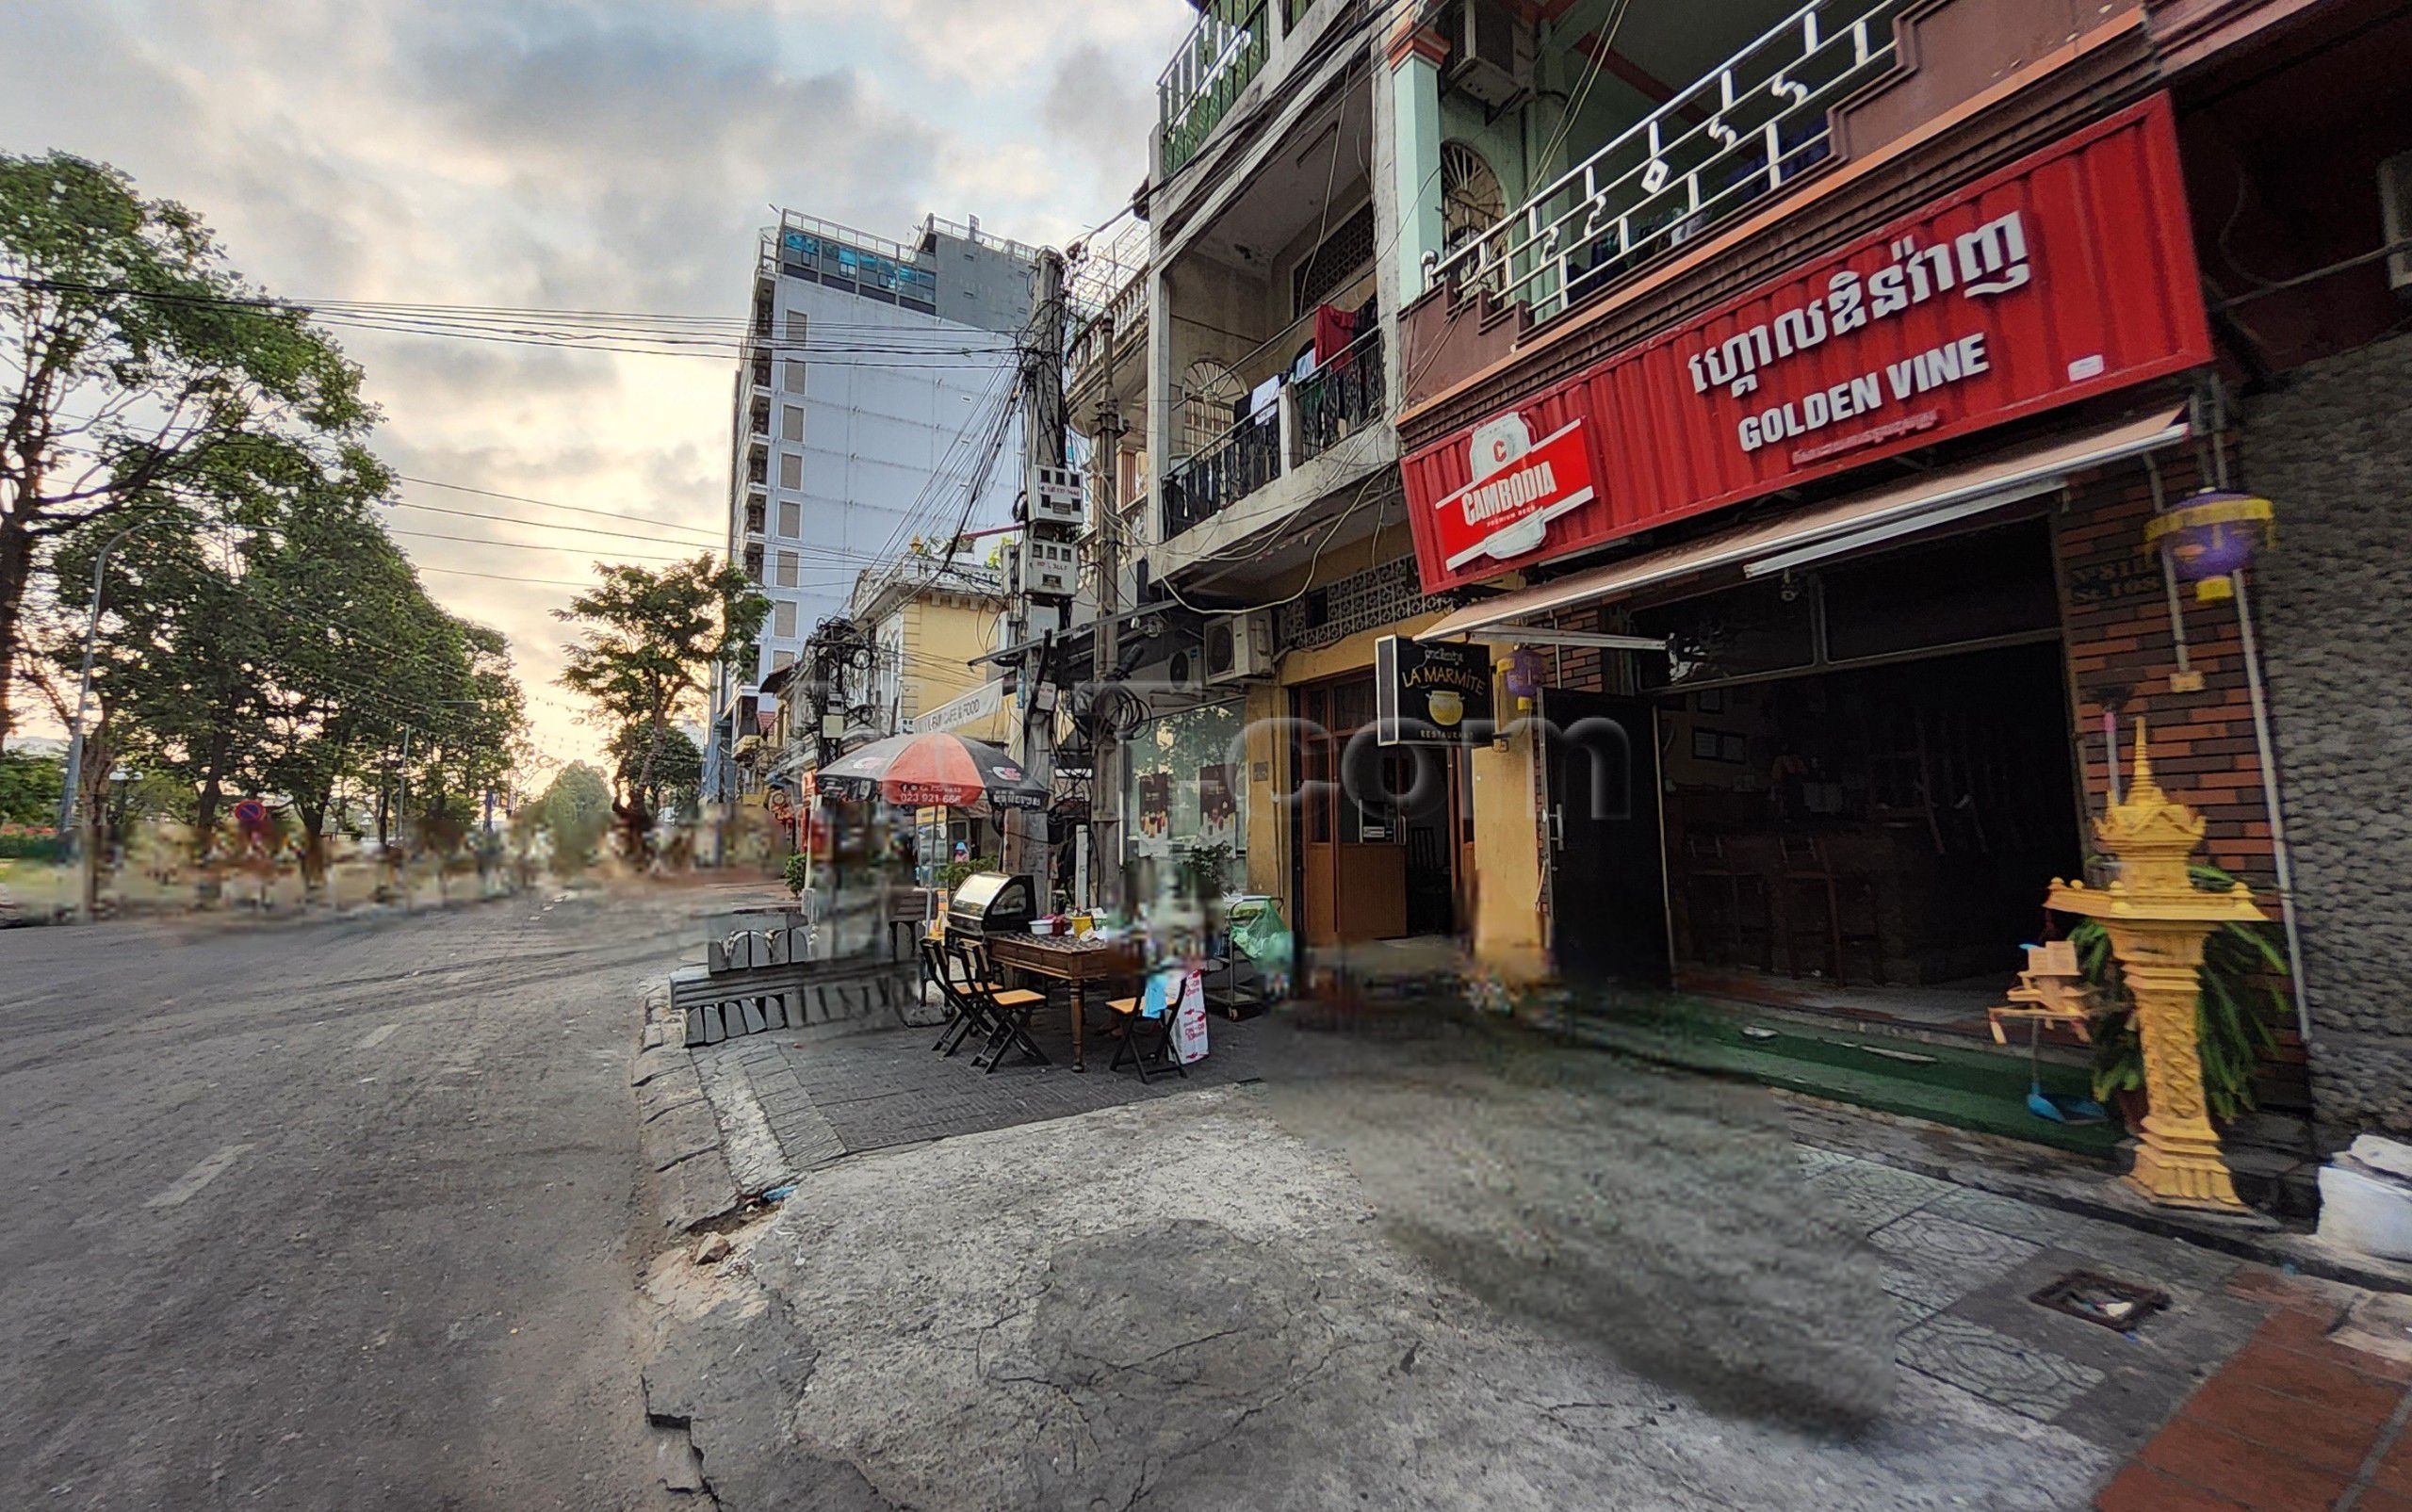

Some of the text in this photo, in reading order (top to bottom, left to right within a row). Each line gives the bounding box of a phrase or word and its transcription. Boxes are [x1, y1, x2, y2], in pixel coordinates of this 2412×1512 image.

[1738, 372, 1882, 452] GOLDEN
[1886, 333, 1989, 400] VINE
[1462, 461, 1557, 527] CAMBODIA
[1402, 669, 1422, 688] LA
